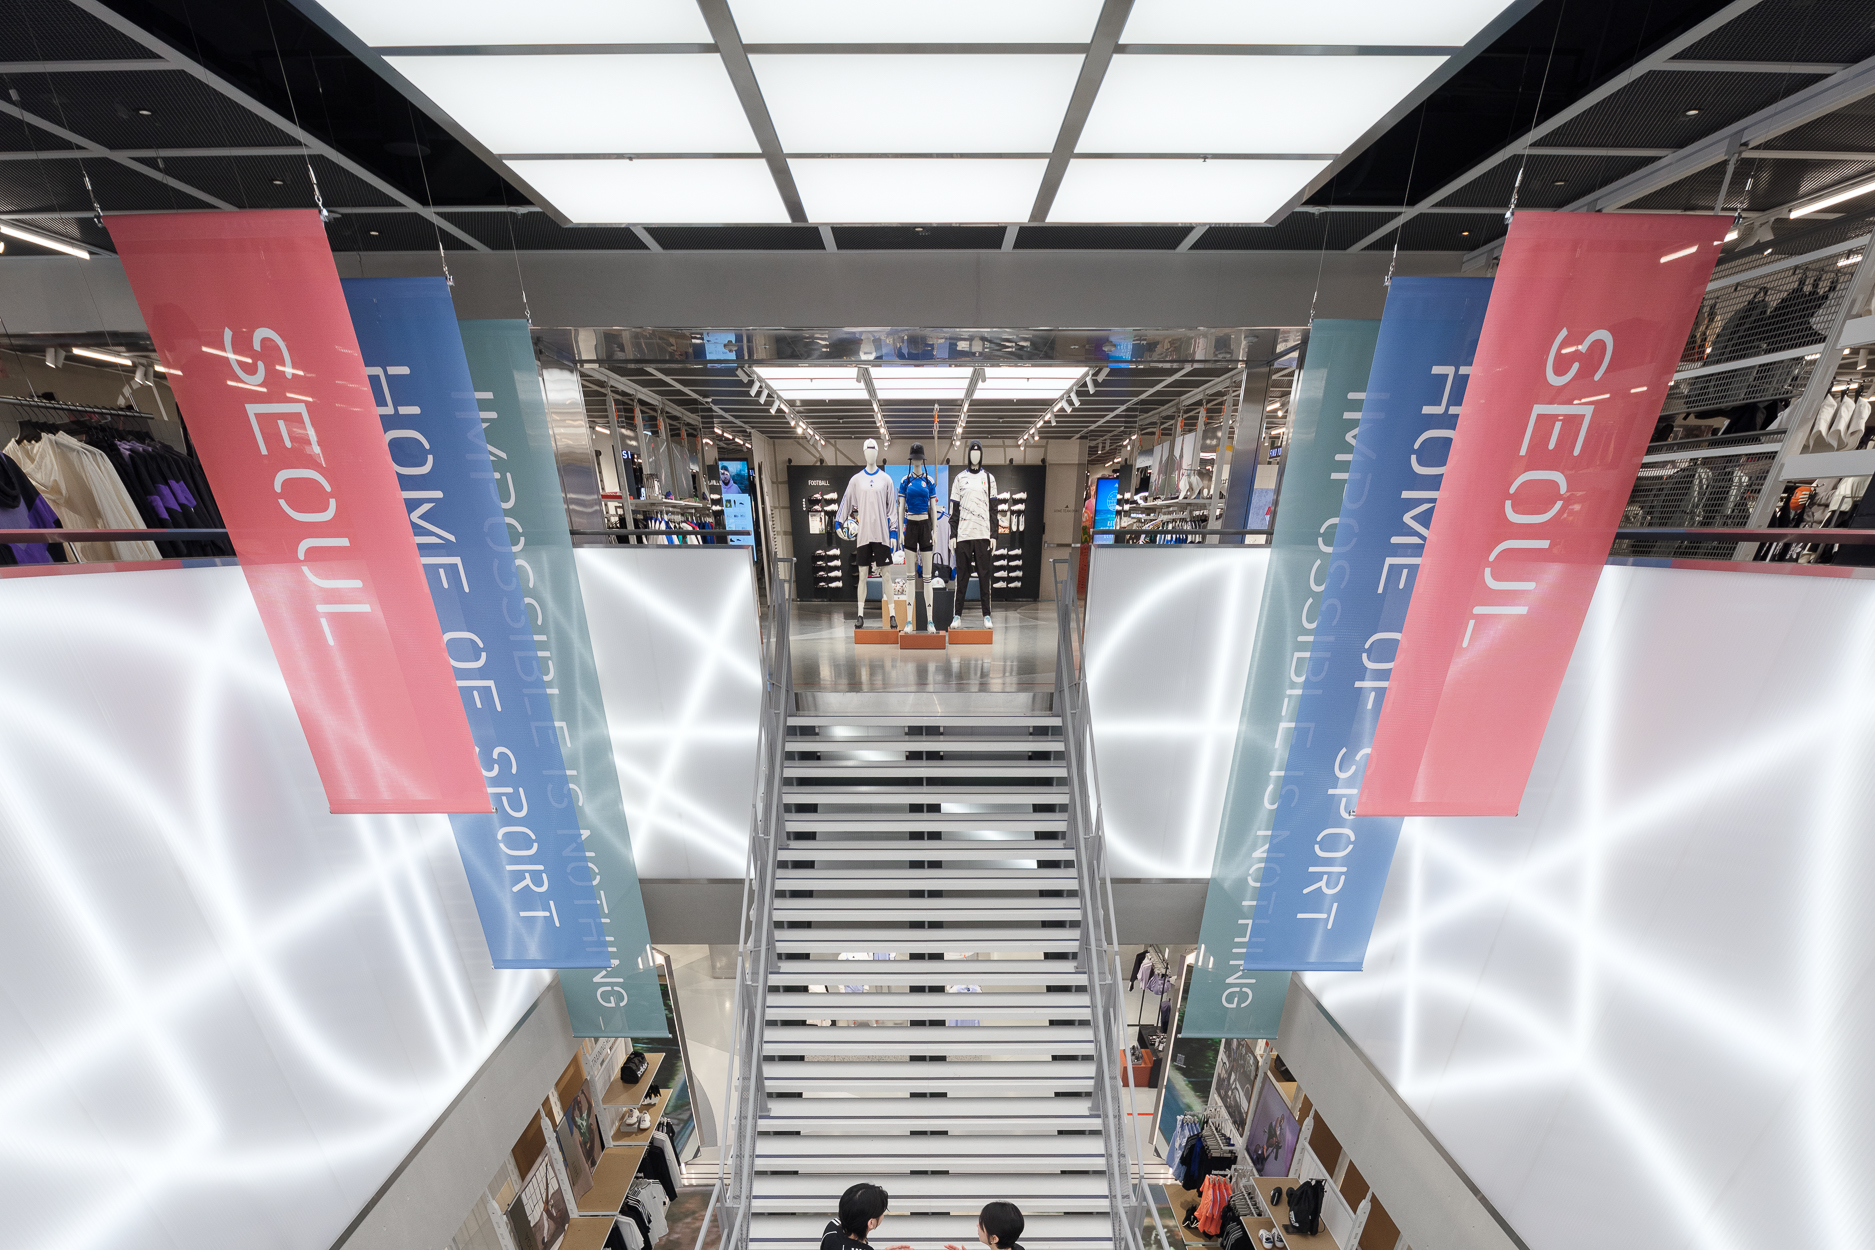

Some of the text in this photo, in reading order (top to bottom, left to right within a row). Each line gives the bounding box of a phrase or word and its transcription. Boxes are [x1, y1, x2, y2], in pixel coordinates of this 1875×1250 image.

[223, 326, 372, 646] SEOUL
[361, 366, 560, 928] HOME OF SPORT
[1275, 392, 1390, 749] IMPOSSIBLE
[1297, 366, 1481, 929] HOME OF SPORT
[1461, 327, 1614, 648] SEOUL
[451, 391, 571, 748] IMPOSSIBLE
[556, 828, 628, 1008] NOTHING
[1221, 829, 1291, 1009] NOTHING
